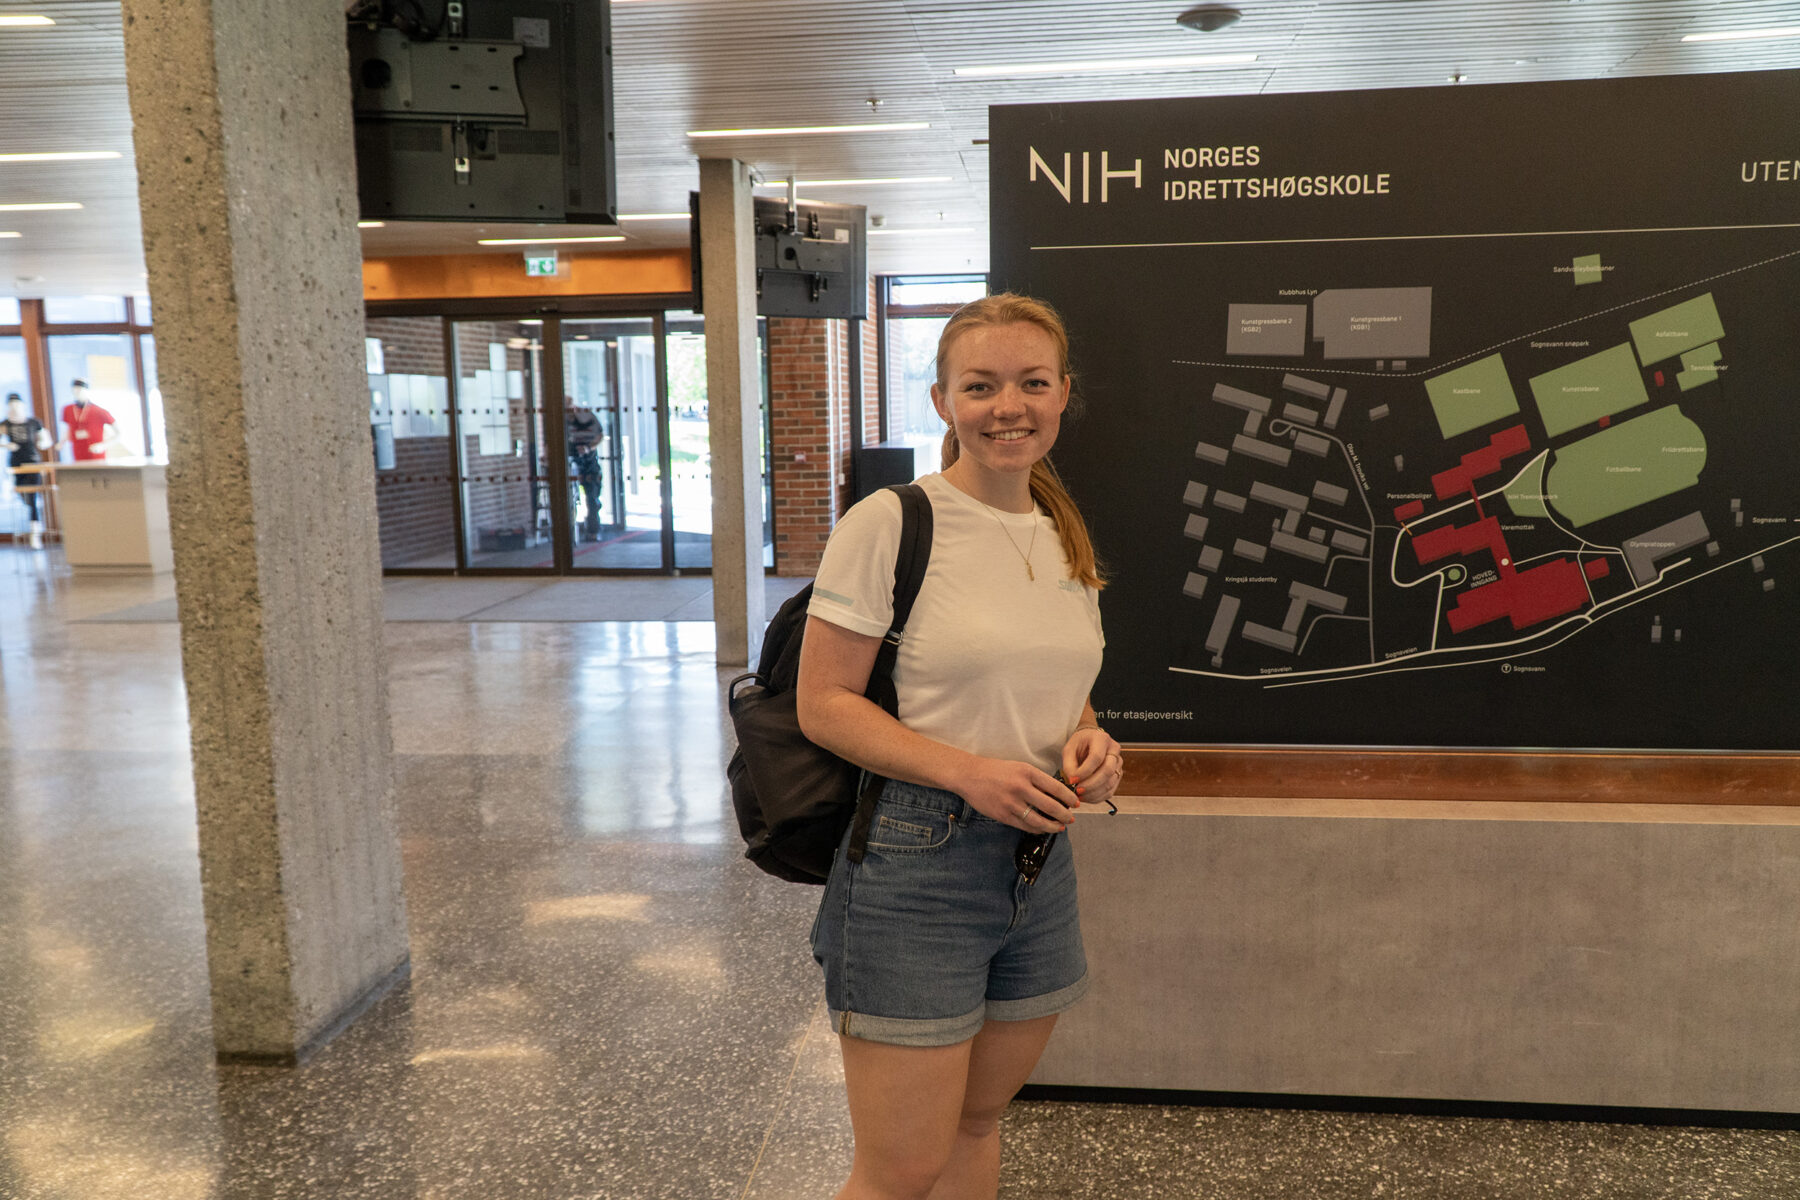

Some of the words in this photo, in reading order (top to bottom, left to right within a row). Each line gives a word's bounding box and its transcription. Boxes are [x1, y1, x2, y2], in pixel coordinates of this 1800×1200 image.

[1164, 145, 1261, 169] NORGES
[1029, 145, 1142, 204] NIH
[1164, 173, 1391, 201] IDRETTSHØGSKOLE
[1241, 318, 1287, 326] Kunstgressbane
[1350, 315, 1397, 324] Kunstgressbane
[1530, 341, 1563, 349] Sognsvann
[1386, 492, 1433, 500] Personalboliger
[1752, 516, 1787, 524] Sognsvann
[1249, 576, 1278, 584] studentby
[1106, 709, 1122, 719] for
[1123, 710, 1193, 721] etasjeoversikt
